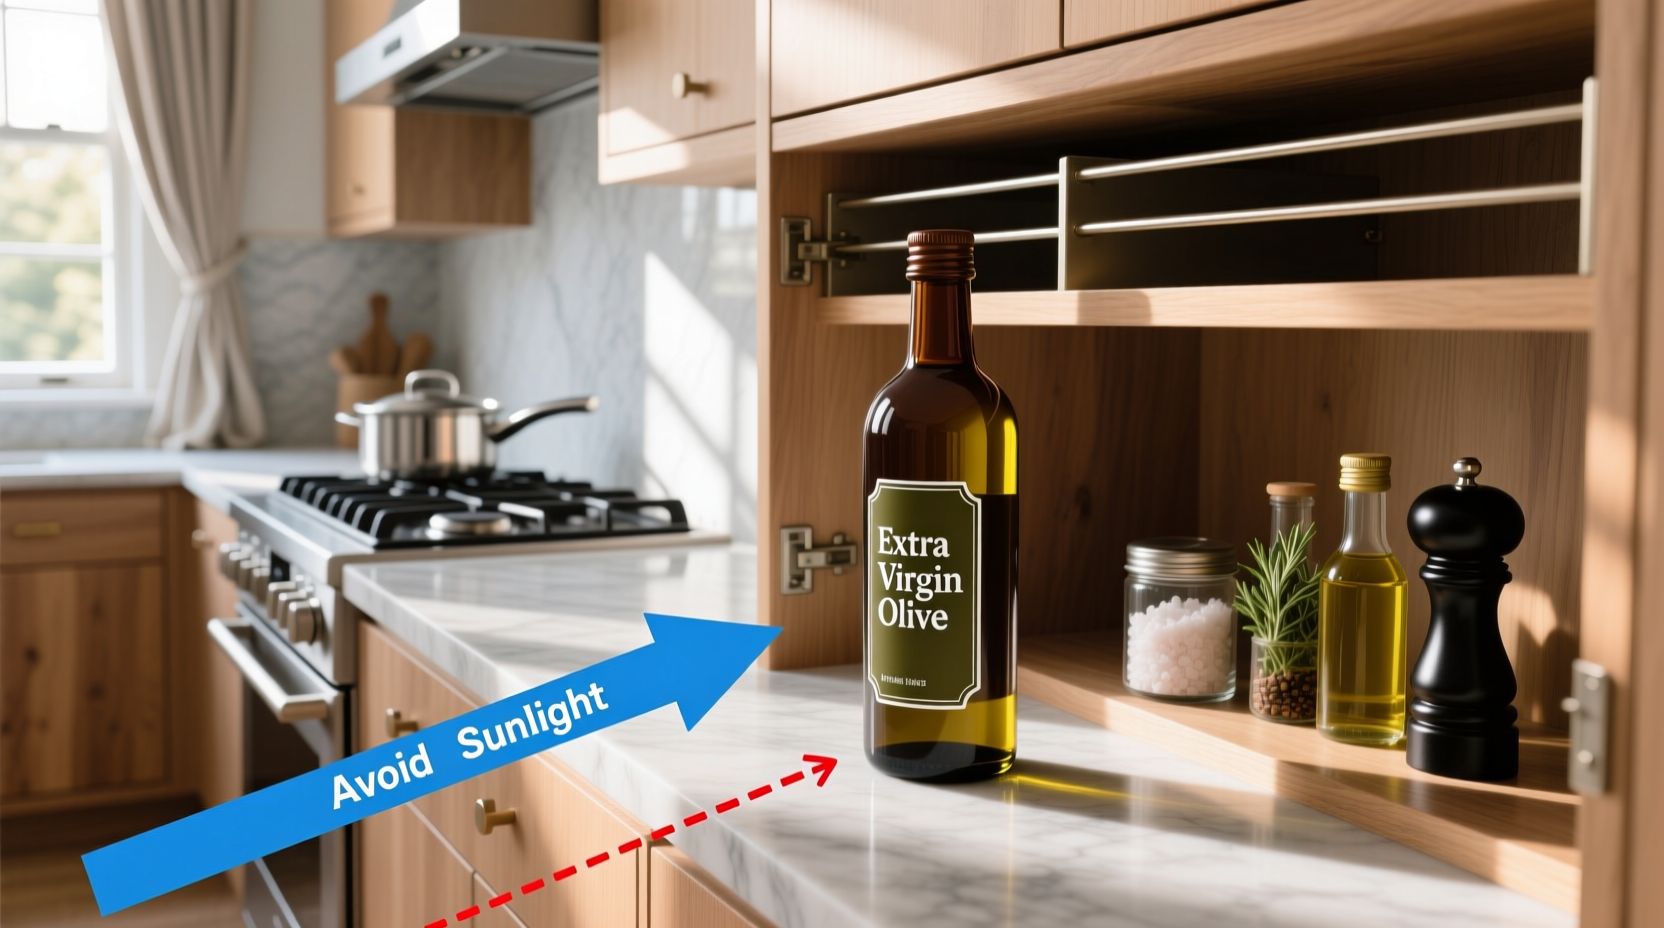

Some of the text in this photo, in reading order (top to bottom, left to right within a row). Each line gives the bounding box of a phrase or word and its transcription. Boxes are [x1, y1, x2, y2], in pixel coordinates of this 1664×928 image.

[877, 525, 950, 558] Extra
[876, 561, 964, 602] Virgin
[877, 596, 949, 631] Olive
